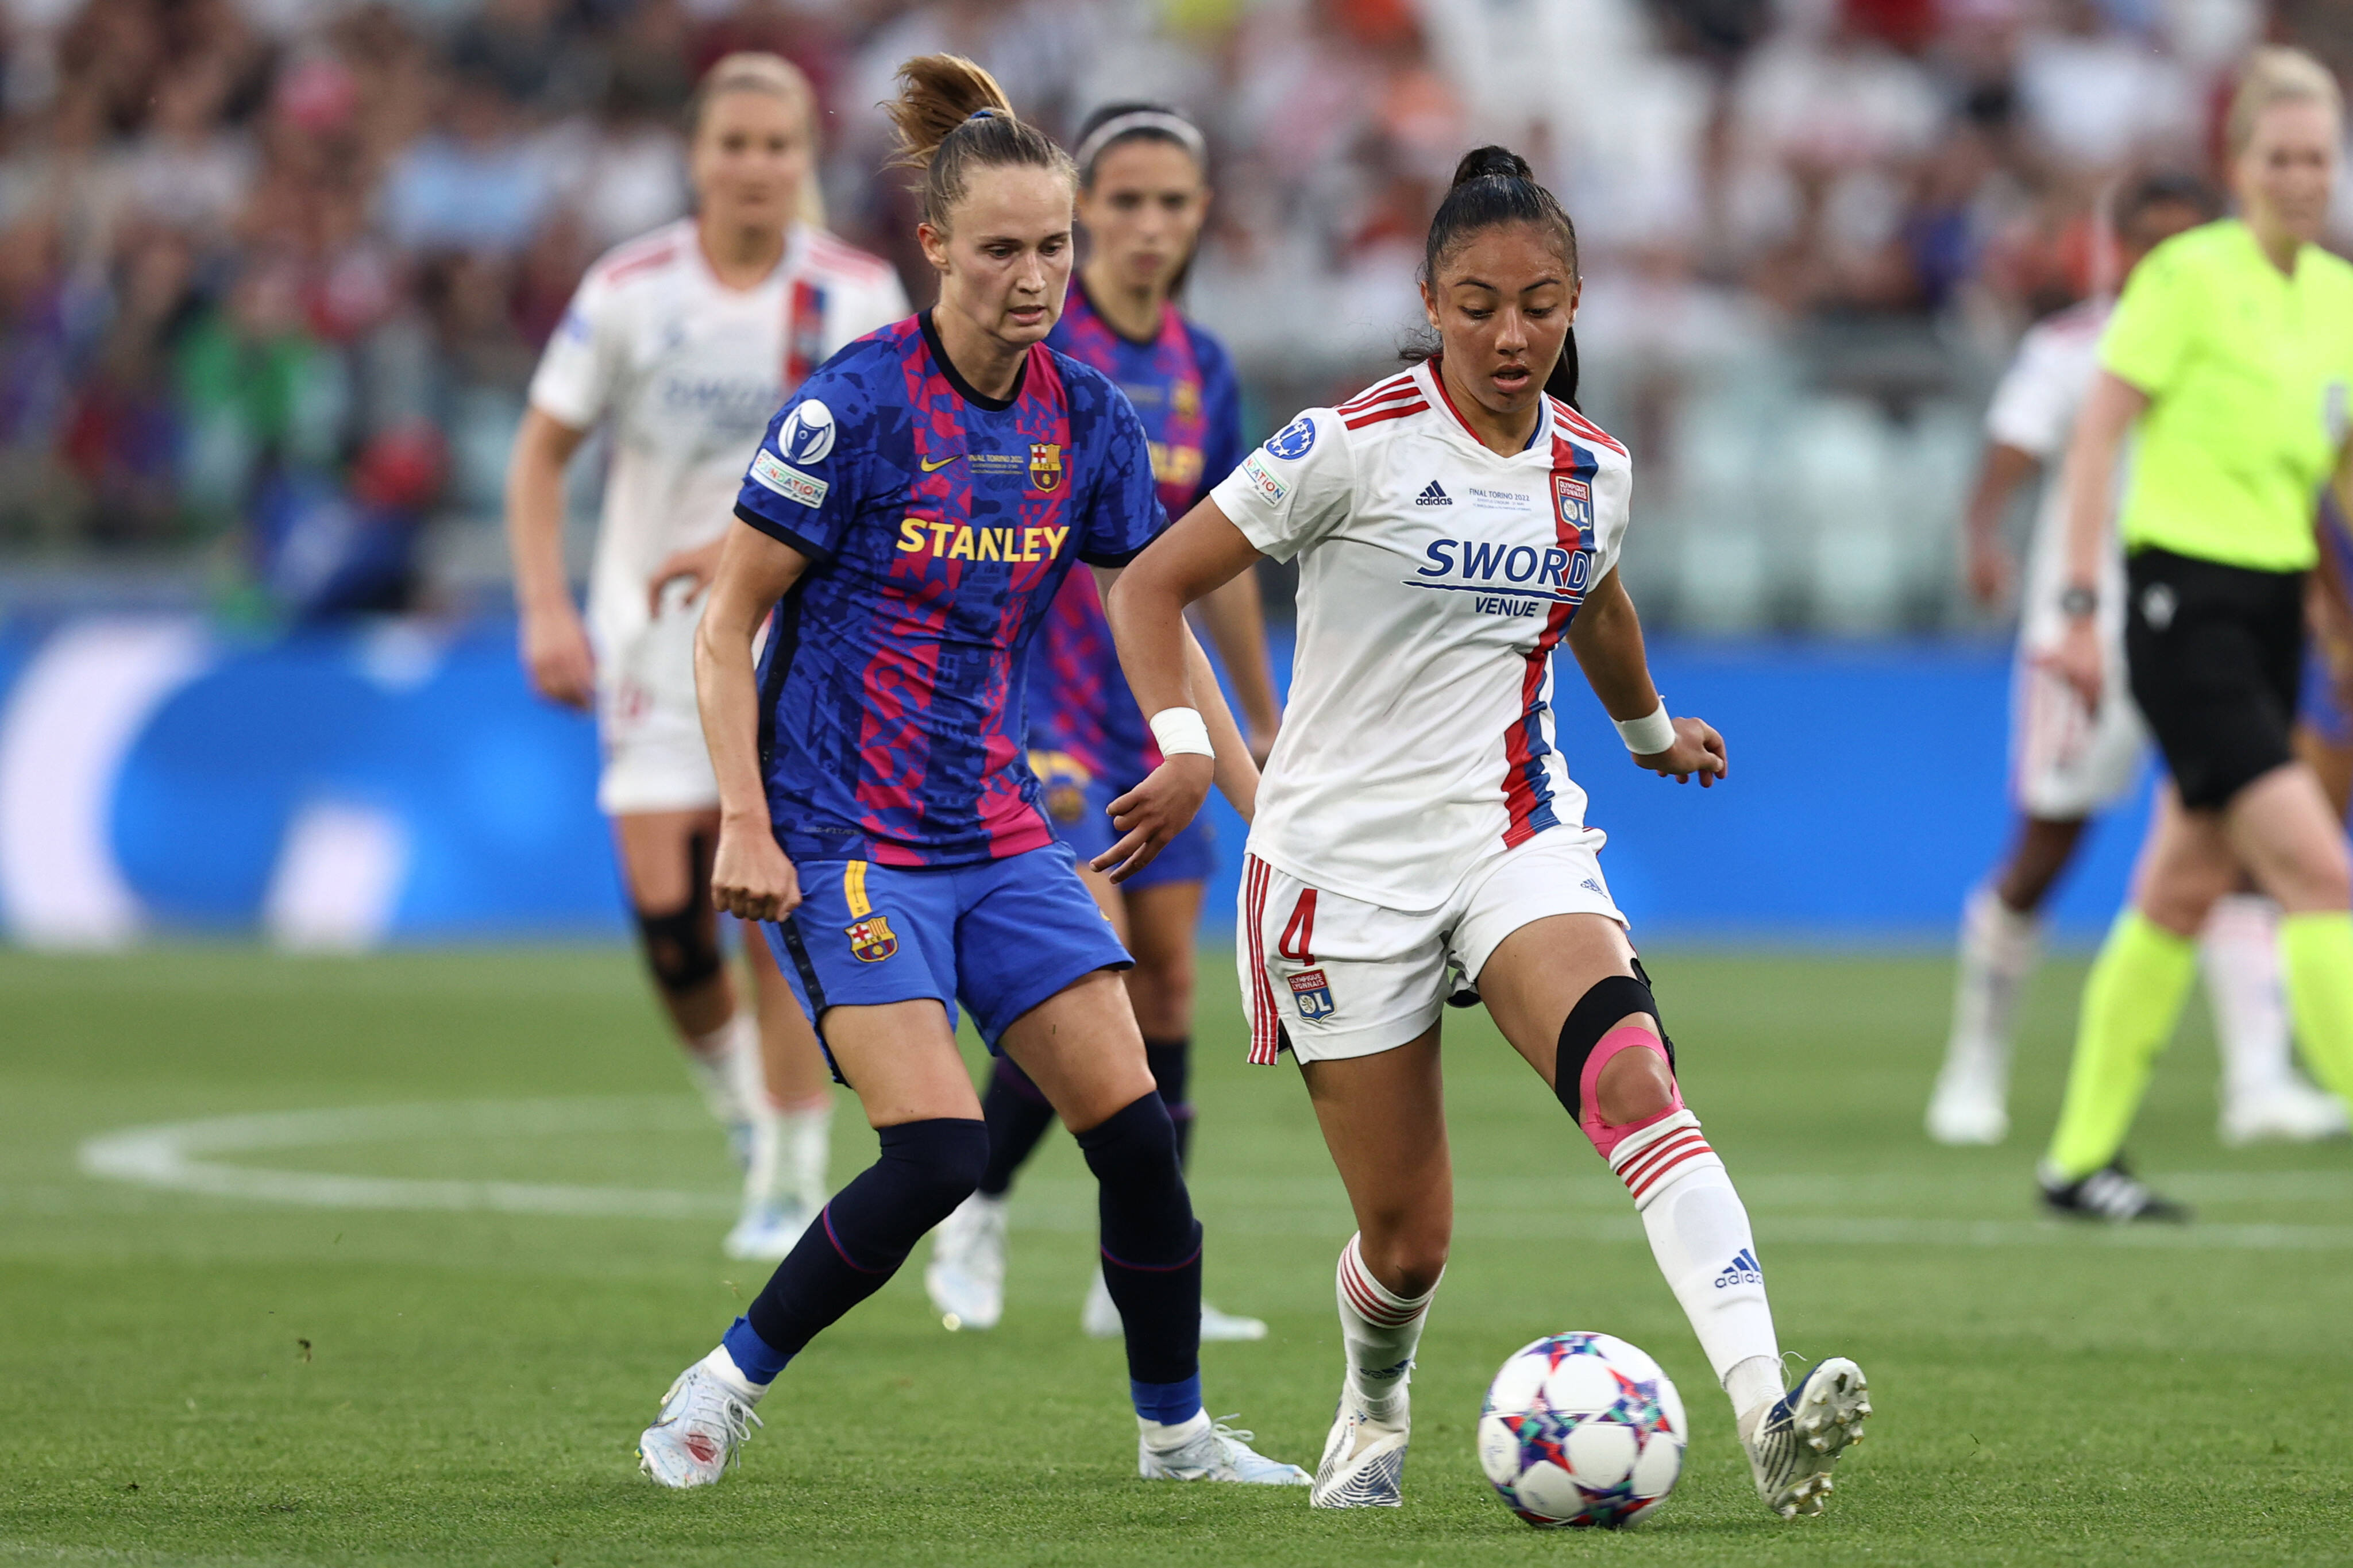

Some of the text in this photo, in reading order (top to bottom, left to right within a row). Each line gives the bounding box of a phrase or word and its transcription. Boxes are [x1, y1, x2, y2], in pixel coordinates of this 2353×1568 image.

[1415, 495, 1453, 505] adidas
[1469, 488, 1487, 497] FINAL
[1488, 491, 1513, 500] TORINO
[1514, 493, 1530, 501] 2022
[896, 517, 1070, 562] STANLEY
[1417, 538, 1591, 590] SWORD
[1475, 596, 1540, 617] VENUE
[1278, 887, 1318, 967] 4
[1289, 972, 1323, 984] OLYMPIQUE
[1291, 978, 1325, 990] LYONNAIS
